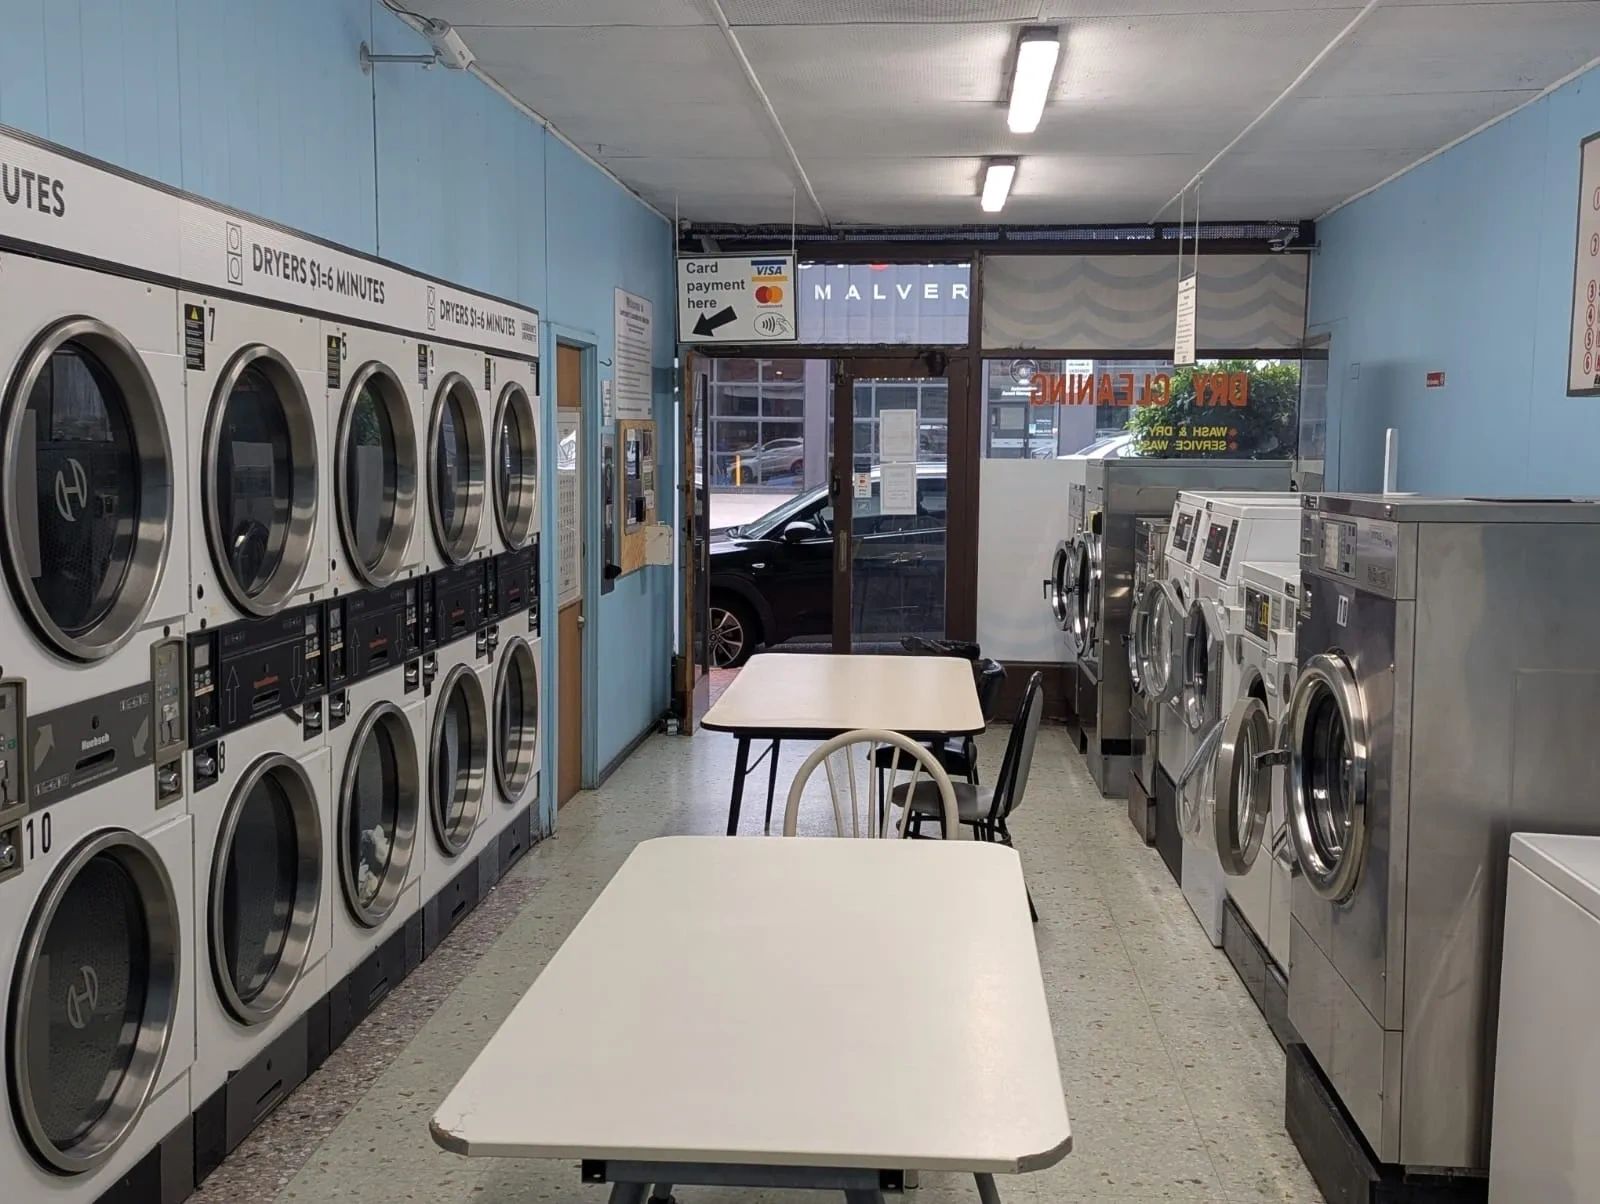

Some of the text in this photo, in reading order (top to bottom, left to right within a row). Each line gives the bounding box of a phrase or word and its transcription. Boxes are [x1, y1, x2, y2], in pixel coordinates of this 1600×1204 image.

[2, 163, 65, 217] UTES
[252, 243, 385, 304] DRYERS $1=6 MINUTES
[686, 261, 718, 274] Card
[757, 266, 783, 276] VISA
[687, 279, 746, 294] payment
[814, 284, 969, 300] MALVER
[440, 299, 469, 326] DRYERS
[470, 307, 485, 331] $1=6
[486, 312, 516, 336] MINUTES
[687, 297, 717, 309] here
[208, 307, 215, 342] 7
[341, 332, 347, 361] 5
[219, 740, 226, 774] 8
[26, 811, 52, 860] 10
